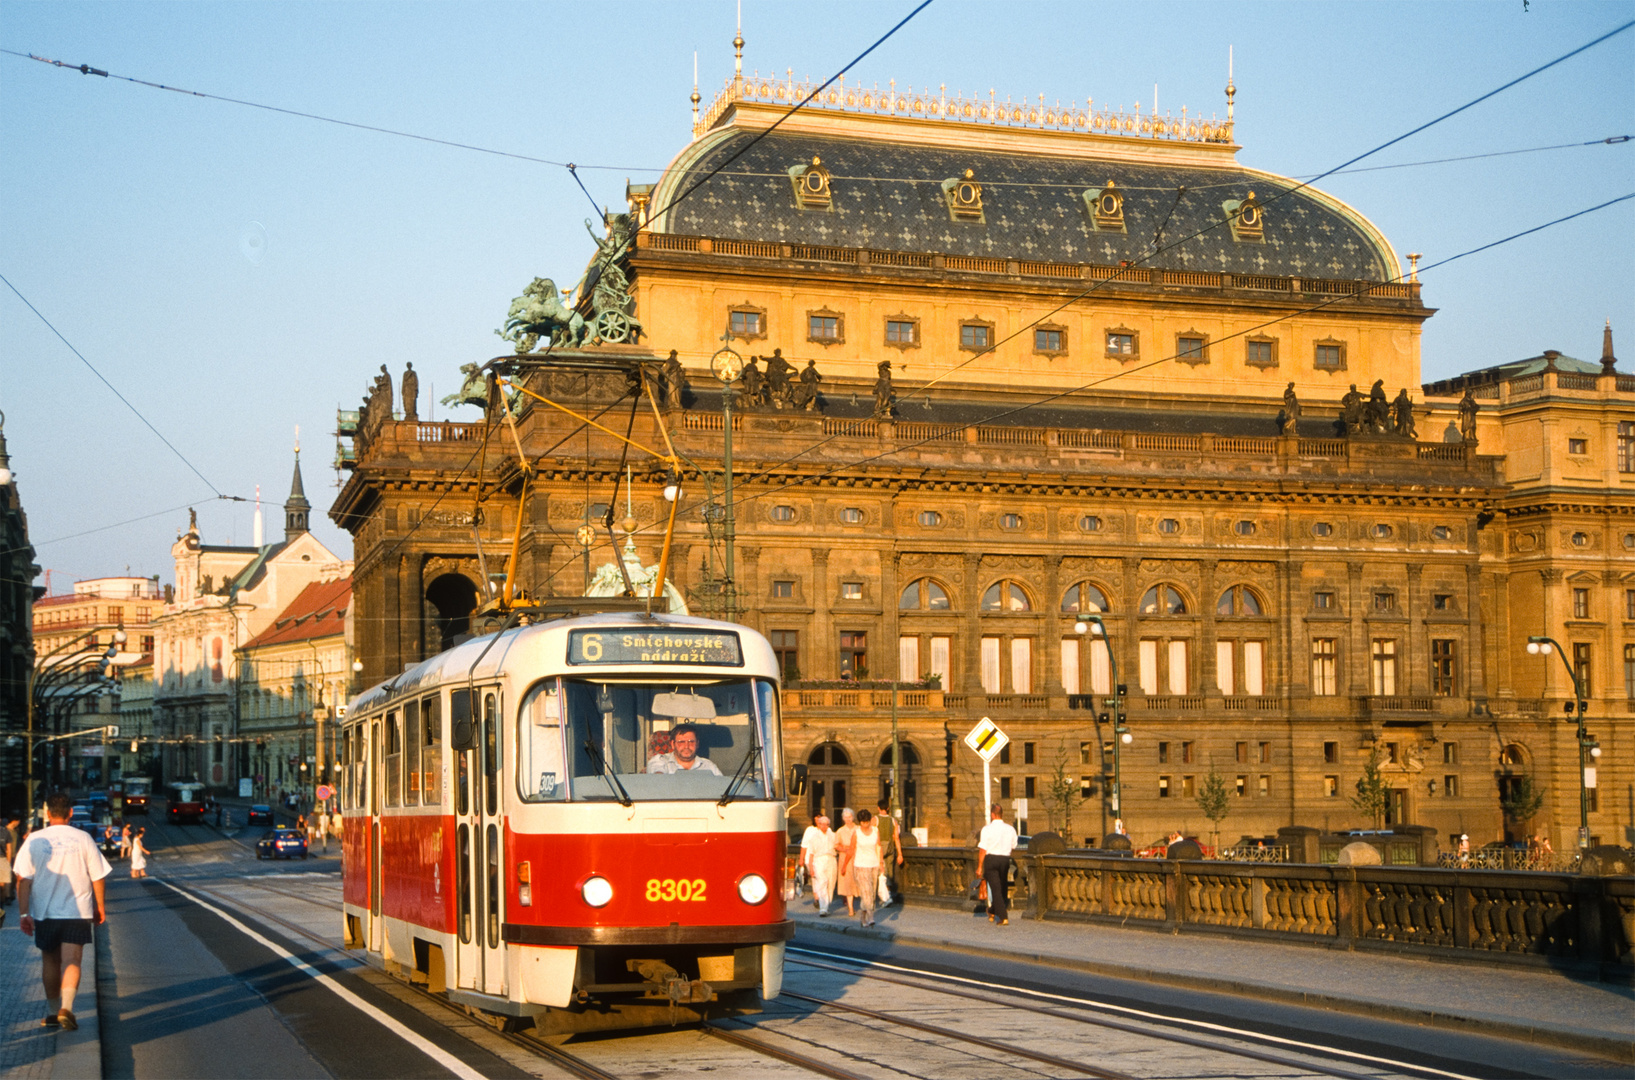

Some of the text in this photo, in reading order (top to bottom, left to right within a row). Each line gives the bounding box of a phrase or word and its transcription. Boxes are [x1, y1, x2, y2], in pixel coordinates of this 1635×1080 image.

[582, 633, 603, 662] 6
[622, 635, 723, 649] Smíchovské
[641, 650, 706, 663] nádraží
[540, 775, 555, 792] 309
[645, 878, 707, 902] 8302
